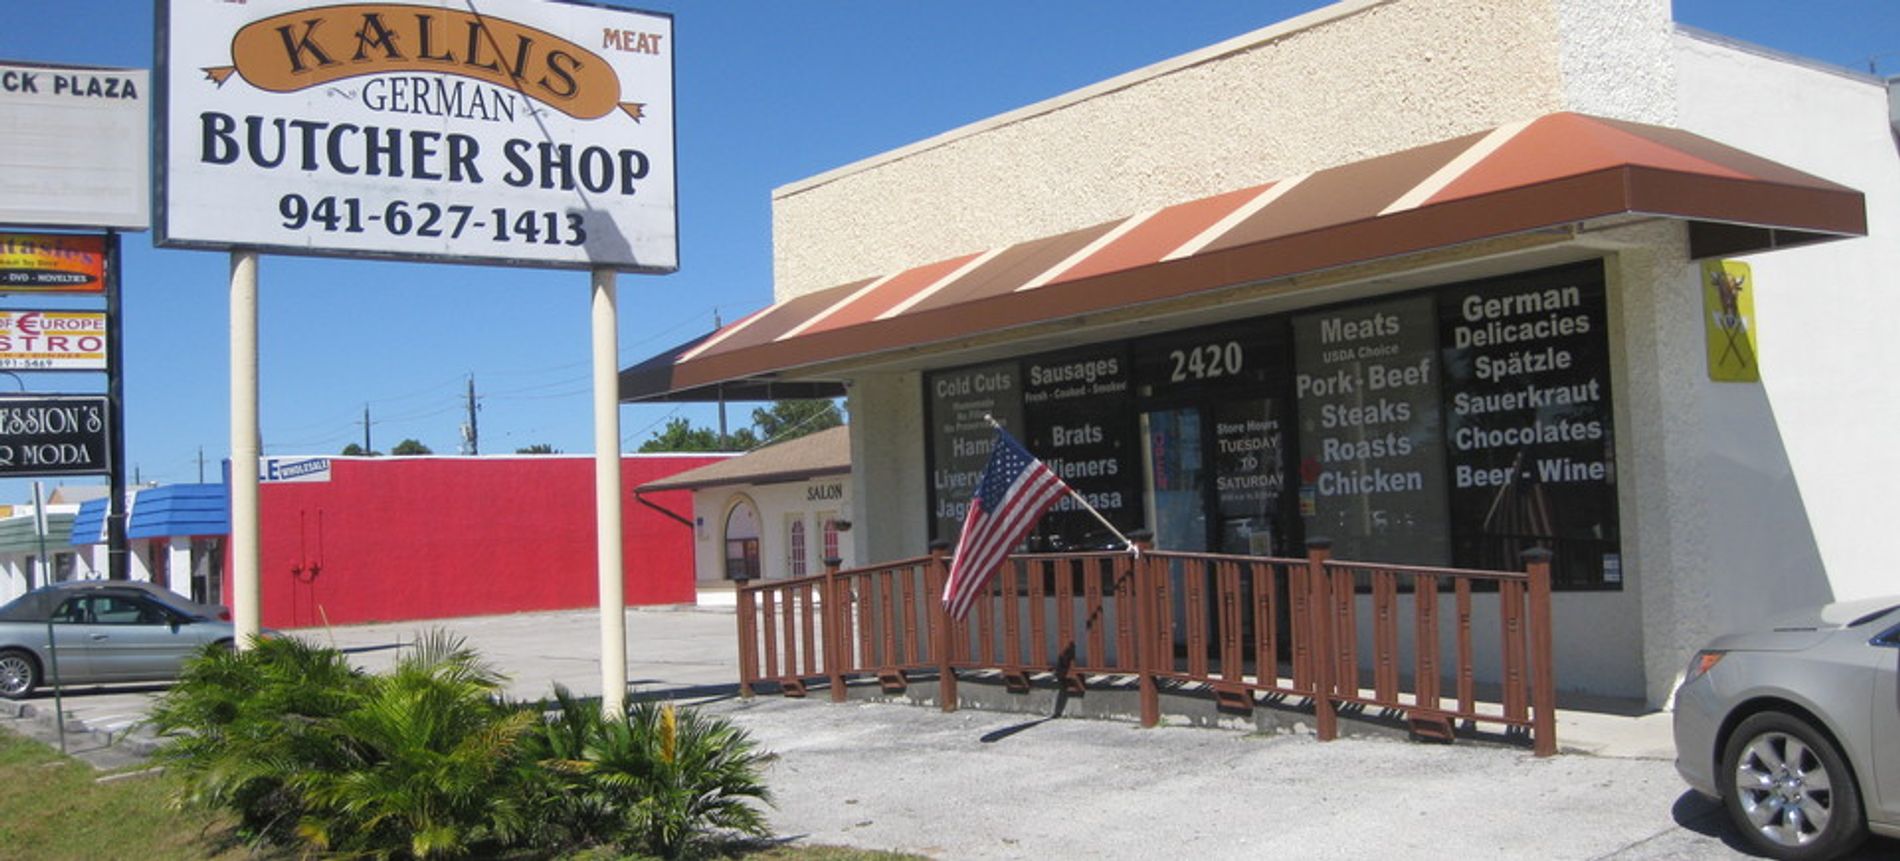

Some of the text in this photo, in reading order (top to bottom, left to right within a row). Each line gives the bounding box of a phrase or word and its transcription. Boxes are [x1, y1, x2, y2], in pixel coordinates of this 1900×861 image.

[275, 12, 585, 98] KALLIS
[603, 28, 662, 55] MEAT
[2, 71, 138, 100] CK PLAZA
[362, 76, 515, 122] GERMAN
[200, 111, 649, 196] BUTCHER SHOP
[279, 193, 588, 247] 941-627-1413
[9, 273, 29, 281] DVD
[1462, 285, 1580, 322] German
[1321, 312, 1400, 344] Meats
[1455, 313, 1591, 349] Delicacies
[1169, 341, 1243, 382] 2420
[1323, 343, 1400, 363] USDA Choice
[1474, 347, 1572, 382] Spätzle
[937, 372, 1011, 397] Cold Cuts
[1030, 357, 1119, 386] Sausages
[1297, 370, 1354, 398] Pork
[1368, 357, 1431, 391] Beef
[1454, 378, 1600, 415] Sauerkraut
[1217, 419, 1279, 435] Store Hours
[1321, 399, 1412, 428] Steaks
[1052, 423, 1103, 447] Brats
[1218, 434, 1278, 453] TUESDAY
[1322, 432, 1412, 462] Roasts
[1456, 417, 1603, 450] Chocolates
[22, 443, 92, 465] MODA
[1241, 456, 1258, 470] TO
[1216, 471, 1284, 491] SATURDAY
[1318, 467, 1423, 497] Chicken
[1456, 464, 1516, 488] Beer
[1537, 458, 1606, 483] Wine
[807, 484, 843, 500] SALON
